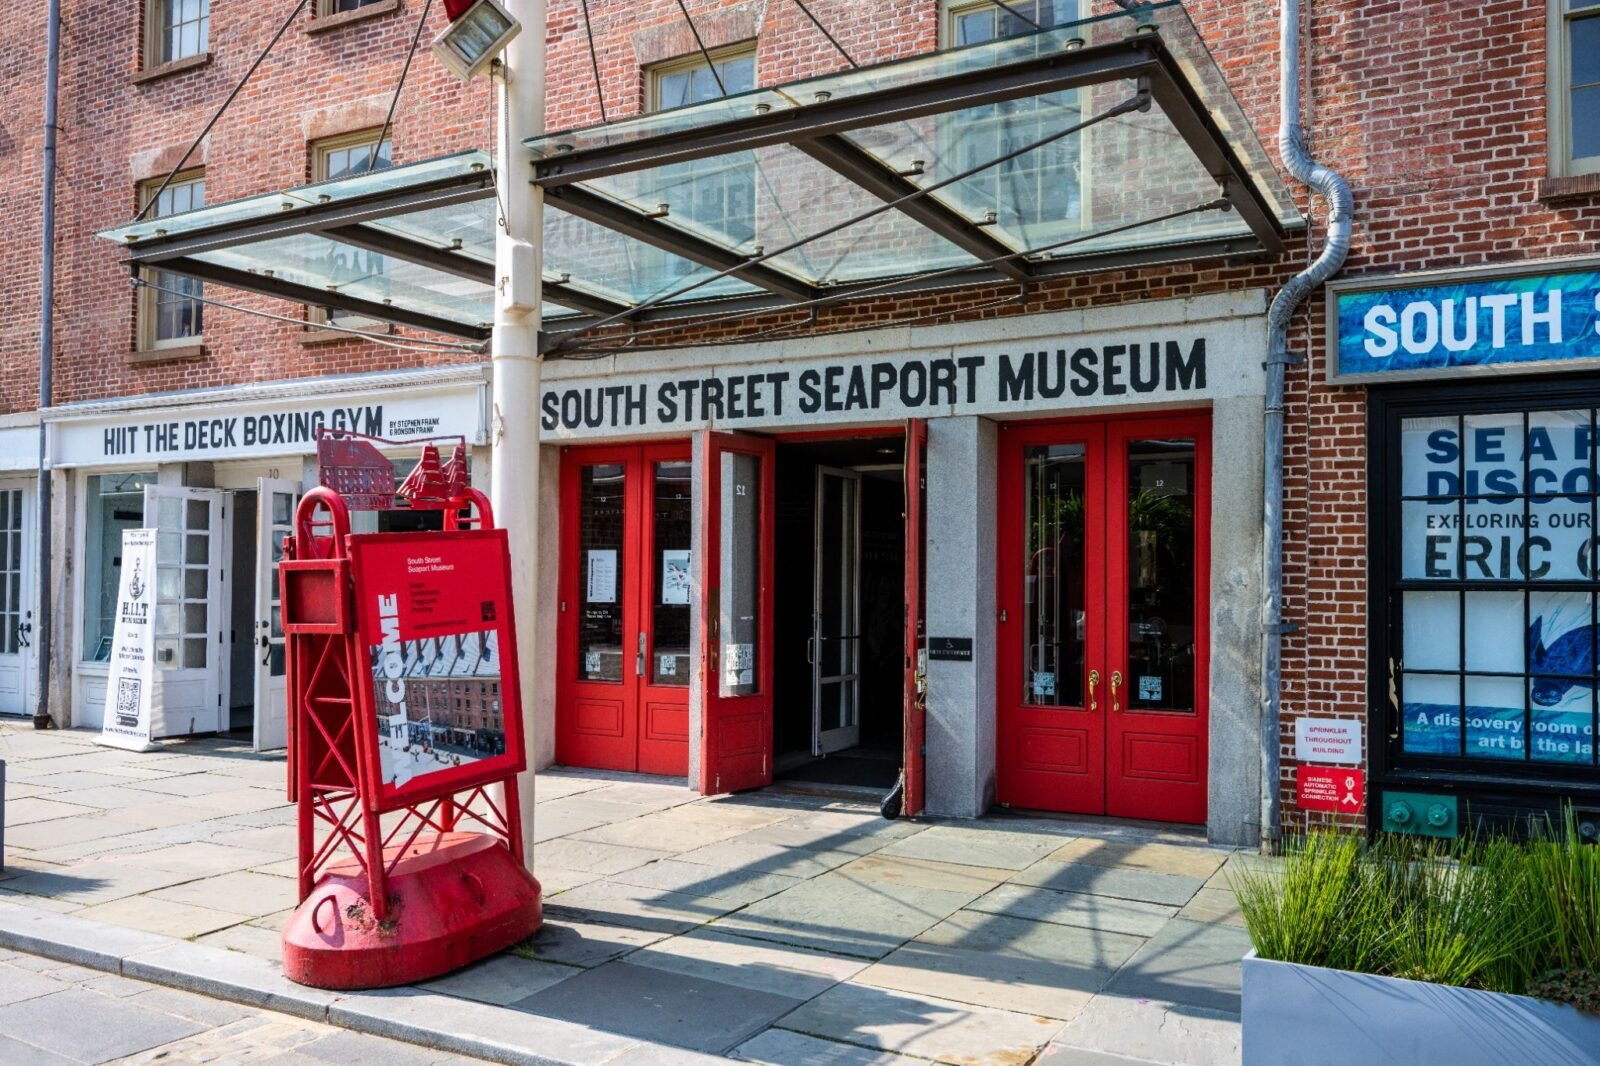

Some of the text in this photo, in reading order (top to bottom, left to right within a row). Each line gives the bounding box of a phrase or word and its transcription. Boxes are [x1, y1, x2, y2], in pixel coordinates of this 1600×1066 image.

[1364, 290, 1562, 357] SOUTH
[541, 338, 1207, 431] SOUTH STREET SEAPORT MUSEUM
[389, 417, 440, 429] BY STEPHEN FRANK
[104, 405, 383, 455] HIIT THE DECK BOXING GYM
[394, 427, 415, 435] RONSON
[416, 426, 434, 434] FRANK
[269, 468, 279, 480] 10
[1548, 512, 1592, 528] OUR
[407, 557, 424, 565] South
[1425, 535, 1552, 579] ERIC
[431, 564, 454, 572] Museum
[1416, 712, 1429, 725] A
[1304, 736, 1352, 744] THROUGHOUT
[1478, 735, 1506, 749] art
[1537, 738, 1570, 753] the
